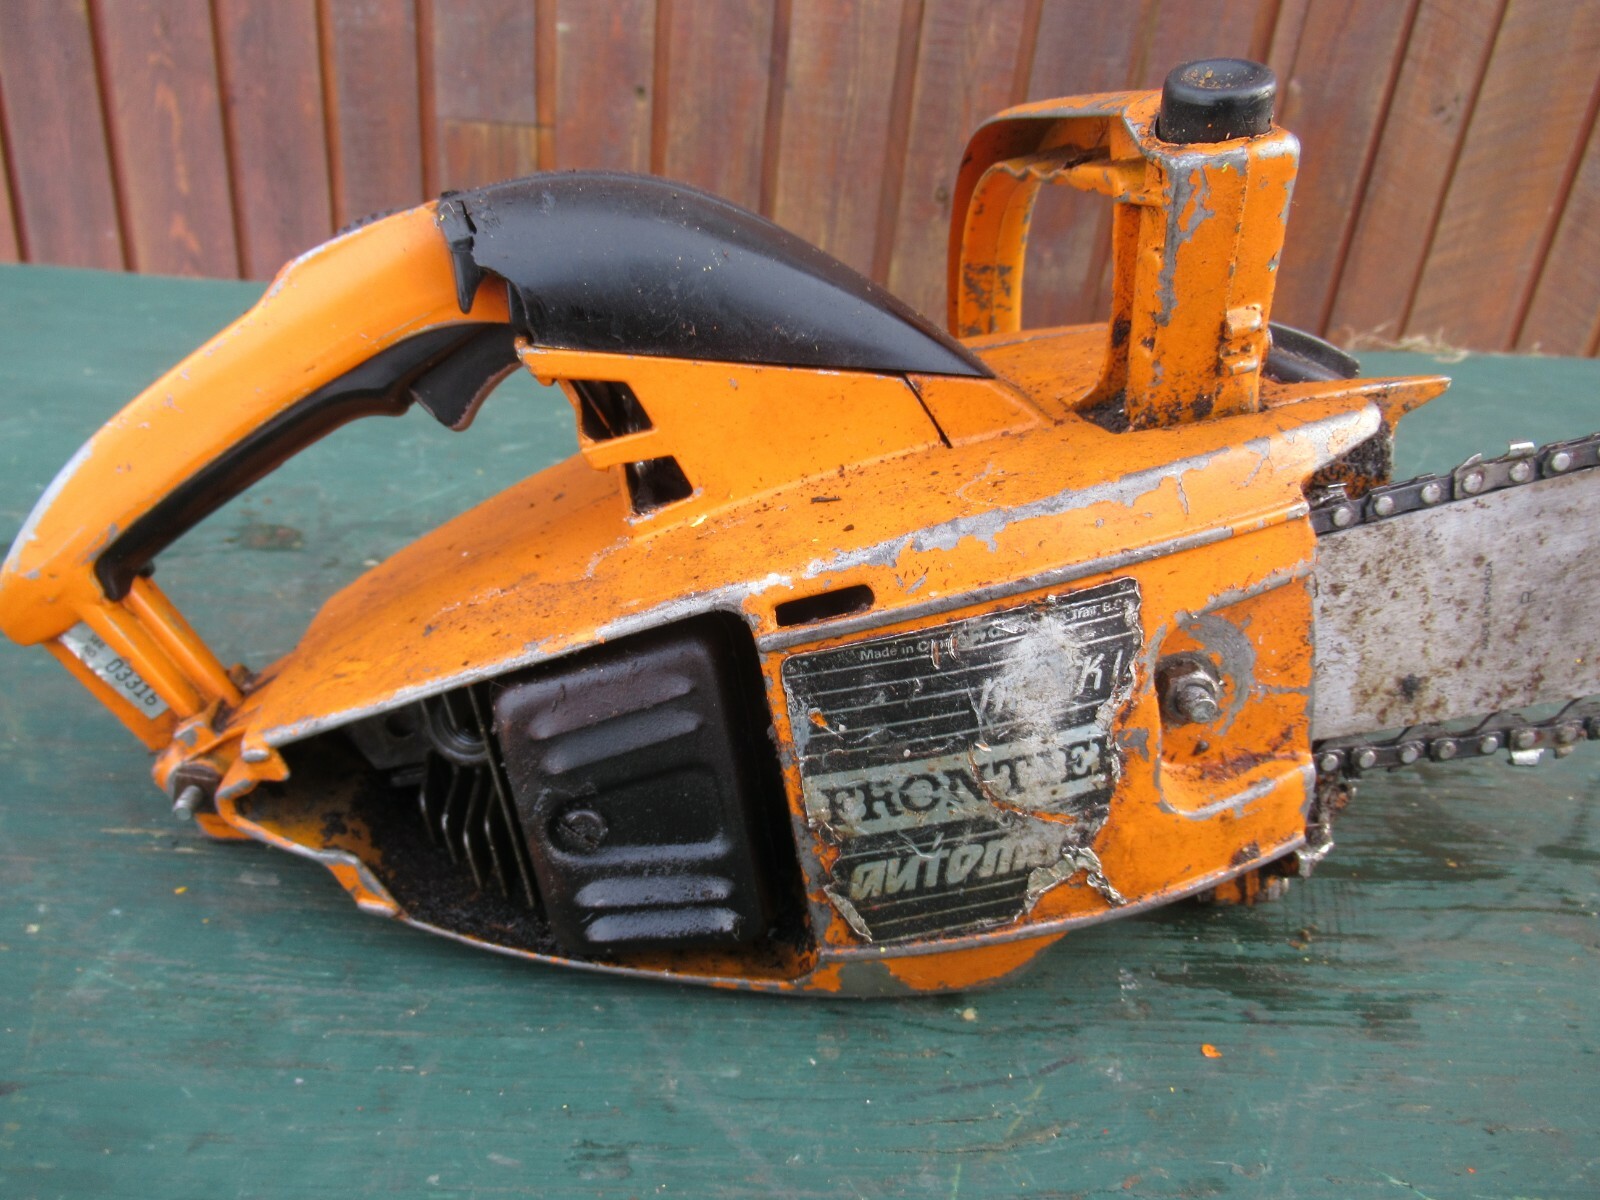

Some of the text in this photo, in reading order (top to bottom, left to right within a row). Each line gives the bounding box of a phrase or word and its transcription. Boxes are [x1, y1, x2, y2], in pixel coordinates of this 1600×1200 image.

[1483, 560, 1493, 604] CANADA
[859, 644, 914, 661] Made in
